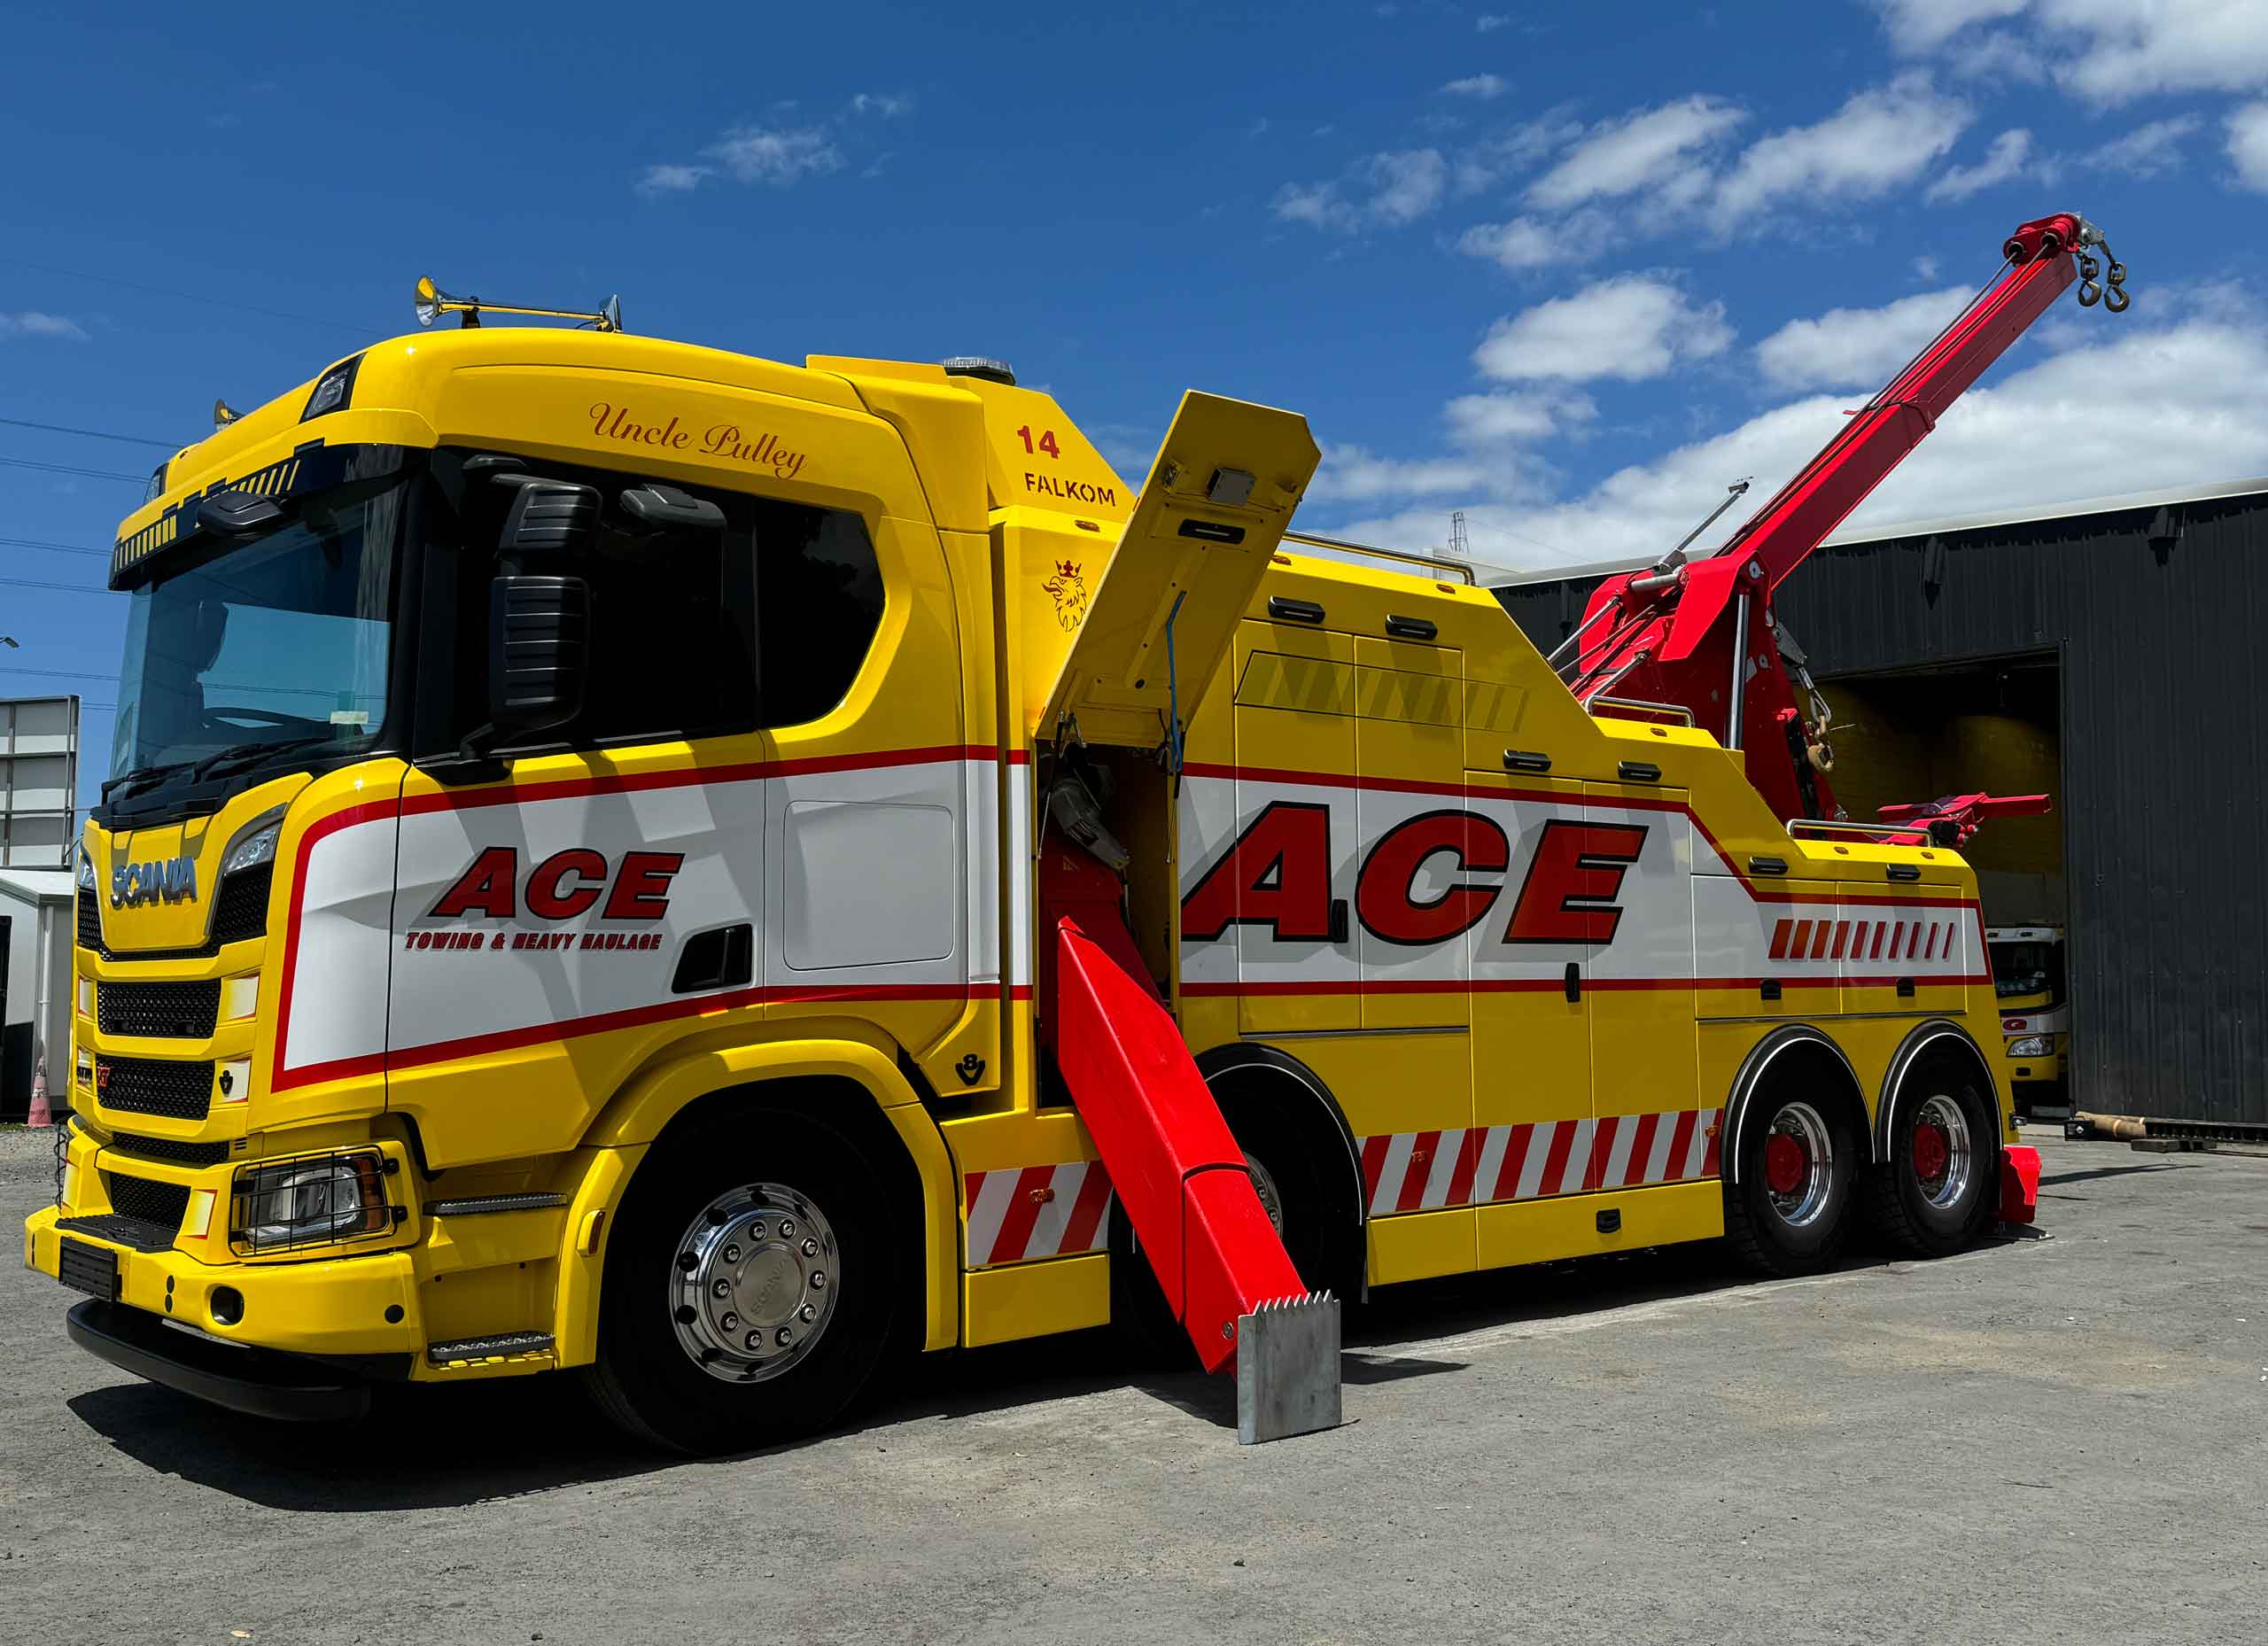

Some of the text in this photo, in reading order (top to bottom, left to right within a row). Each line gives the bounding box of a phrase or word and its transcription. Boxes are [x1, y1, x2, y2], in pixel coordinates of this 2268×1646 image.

[589, 402, 808, 479] Uncle Pulley
[1017, 425, 1060, 459] 14
[1024, 472, 1116, 507] FALKOM
[111, 856, 198, 910] SCANIA
[427, 847, 686, 920] ACE
[1180, 801, 1650, 945] ACE
[405, 932, 664, 951] TOWING & HEAVY HAULAGE
